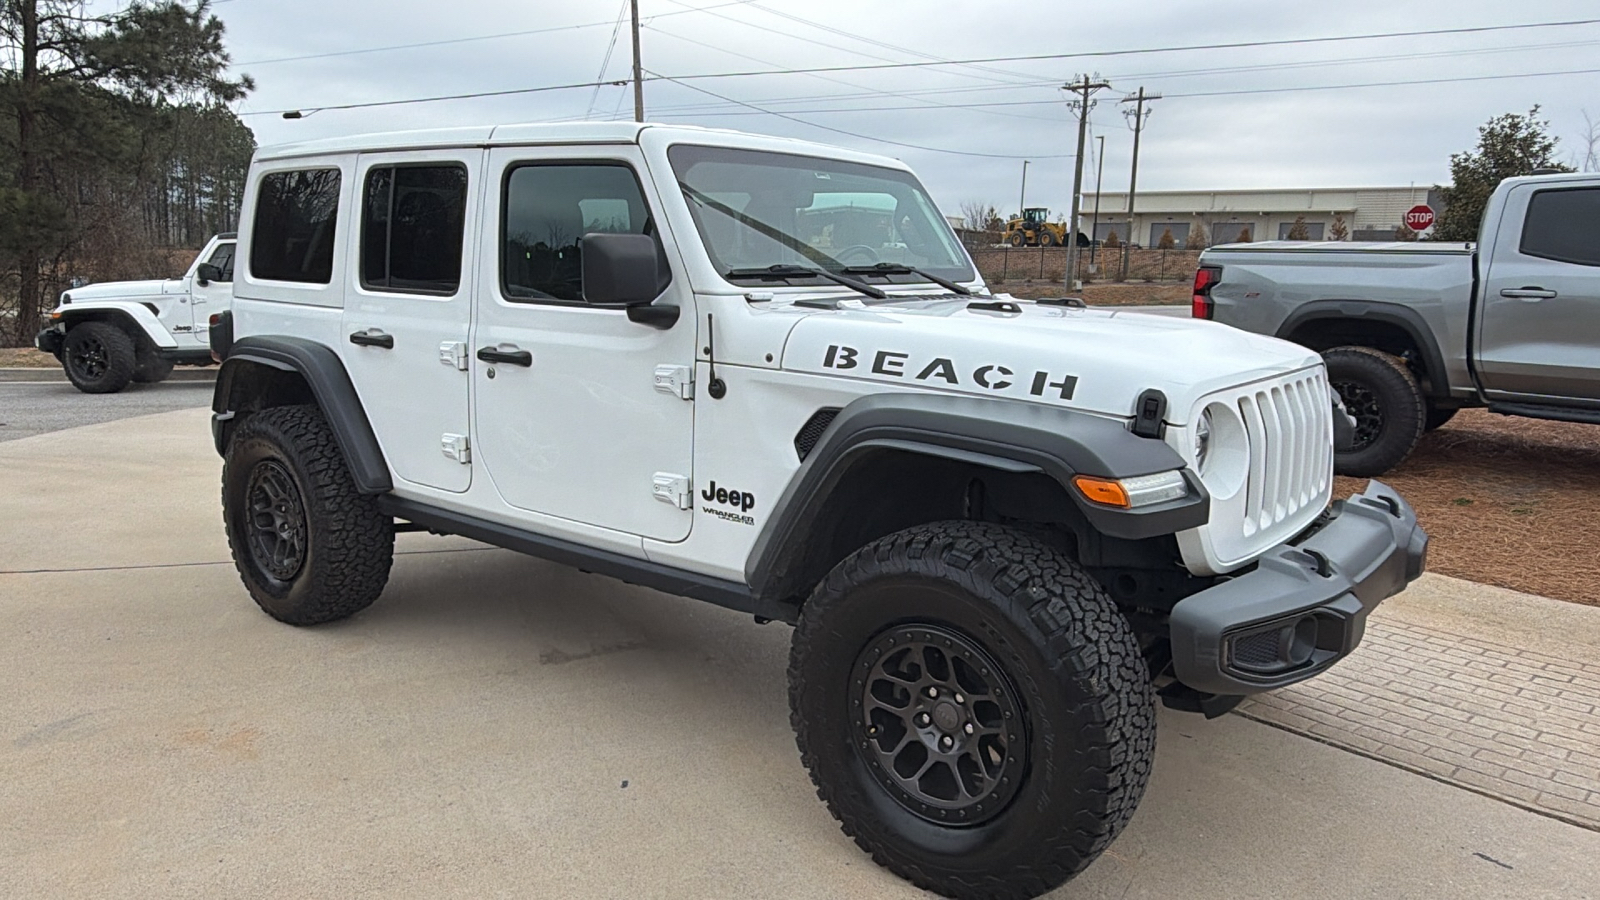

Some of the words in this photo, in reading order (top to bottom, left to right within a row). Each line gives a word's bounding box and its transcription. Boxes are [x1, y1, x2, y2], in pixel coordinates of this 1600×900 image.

[1407, 212, 1433, 223] STOP
[823, 344, 1079, 401] BEACH
[701, 480, 755, 513] Jeep
[702, 506, 755, 523] WRANGLER
